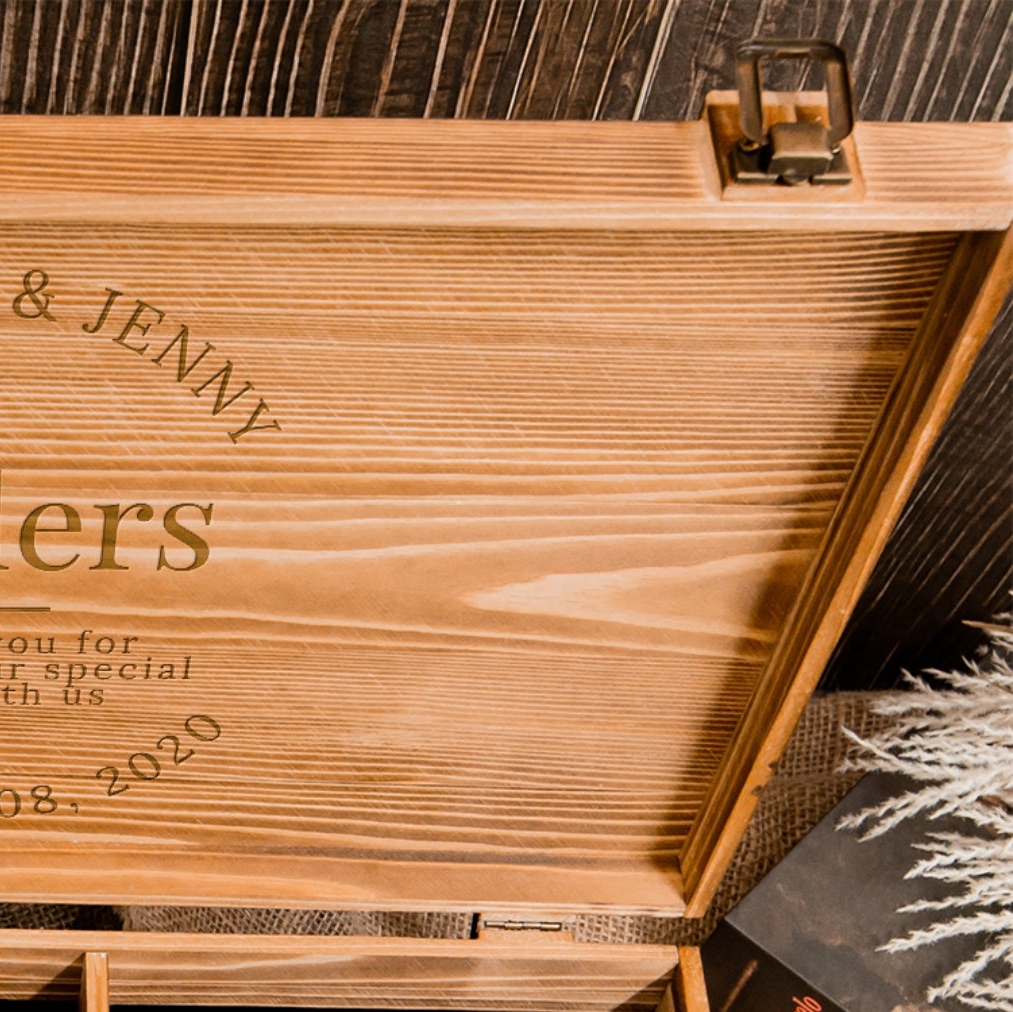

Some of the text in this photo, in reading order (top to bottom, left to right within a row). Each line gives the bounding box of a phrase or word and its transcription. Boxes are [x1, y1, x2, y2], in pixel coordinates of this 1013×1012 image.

[12, 269, 57, 322] &
[82, 287, 282, 445] JENNY
[77, 629, 140, 656] for
[43, 656, 193, 687] special
[63, 687, 105, 706] us
[95, 713, 223, 797] 2020
